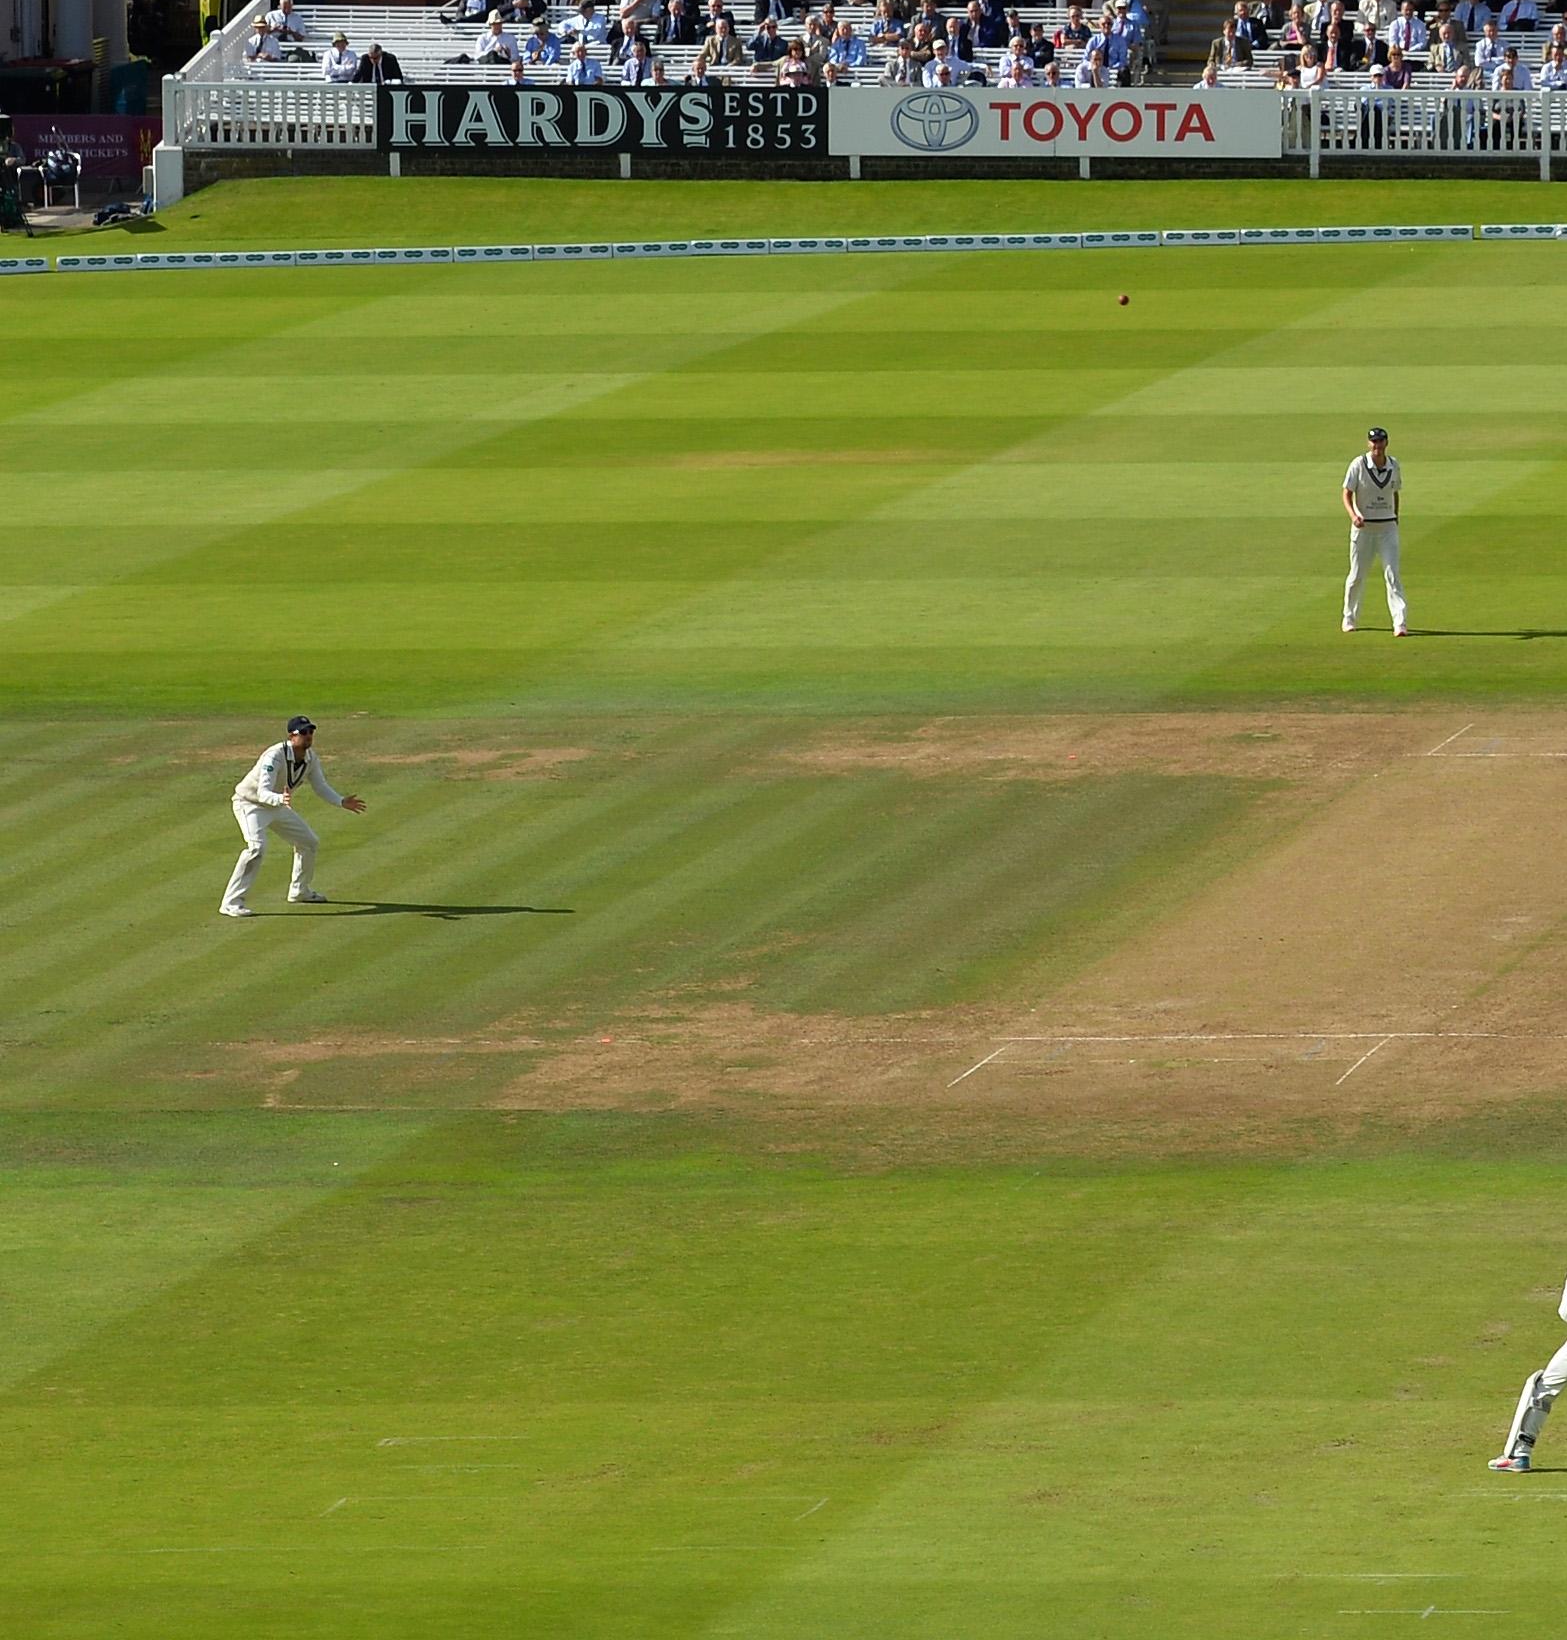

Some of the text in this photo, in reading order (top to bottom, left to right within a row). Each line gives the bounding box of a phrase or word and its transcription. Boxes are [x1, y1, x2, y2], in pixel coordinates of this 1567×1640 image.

[724, 92, 818, 117] ESTD
[989, 101, 1215, 142] TOYOTA
[99, 134, 124, 144] AND
[725, 123, 817, 149] 1853
